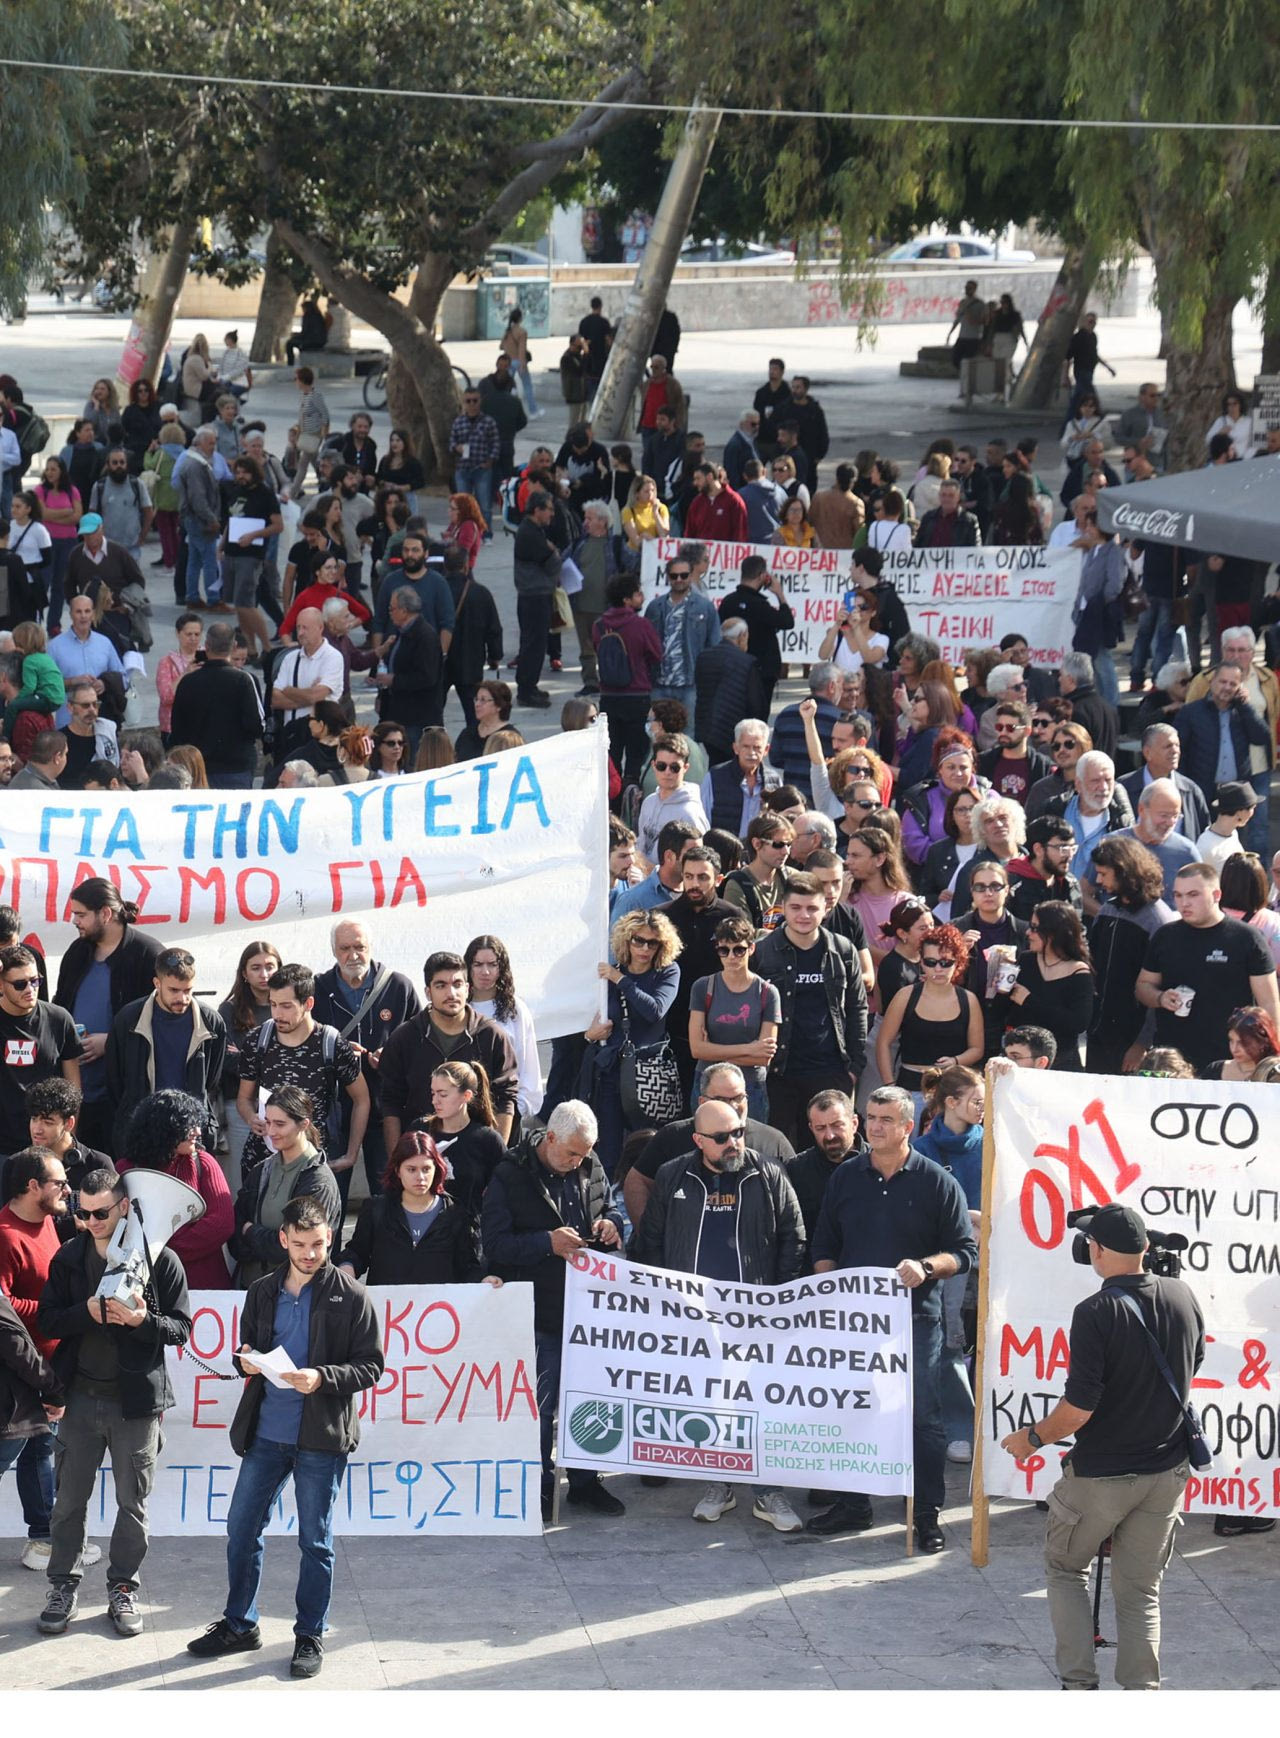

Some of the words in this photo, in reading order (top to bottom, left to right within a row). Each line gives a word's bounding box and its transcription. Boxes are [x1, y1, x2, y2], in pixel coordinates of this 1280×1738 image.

[1112, 502, 1183, 538] Coca-Cola
[931, 573, 1010, 597] ΑΥΞΗΣΕΙΣ
[919, 611, 994, 639] ΤΑΞΙΚΗ
[39, 806, 146, 860] ΓΙΑ
[172, 797, 306, 860] ΤΗΝ
[342, 755, 552, 847] ΥΓΕΙΑ
[328, 856, 428, 913] ΓΙΑ
[1021, 1098, 1141, 1250] ΟΧΙ
[1151, 1103, 1259, 1149] στο
[1141, 1186, 1217, 1233] στην
[572, 1253, 617, 1282] ΟΧΙ
[629, 1270, 704, 1298] ΣΤΗΝ
[714, 1275, 910, 1307] ΥΠΟΒΑΘΜΙΣΗ
[588, 1289, 651, 1315] ΤΩΝ
[661, 1300, 892, 1336] ΝΟΣΟΚΟΜΕΙΩΝ
[569, 1324, 711, 1359] ΔΗΜΟΣΙΑ
[722, 1342, 775, 1364] ΚΑΙ
[784, 1345, 908, 1374] ΔΩΡΕΑΝ
[605, 1366, 694, 1397] ΥΓΕΙΑ
[704, 1378, 754, 1402] ΓΙΑ
[764, 1383, 872, 1410] ΟΛΟΥΣ
[764, 1421, 842, 1438] ΣΩΜΑΤΕΙΟ
[764, 1439, 879, 1456] ΕΡΓΑΖΟΜΕΝΩΝ
[637, 1445, 753, 1472] ΗΡΑΚΛΕΙΟΥ
[765, 1456, 826, 1472] ΕΝΩΣΗΣ
[830, 1459, 912, 1477] ΗΡΑΚΛΕΙΟΥ
